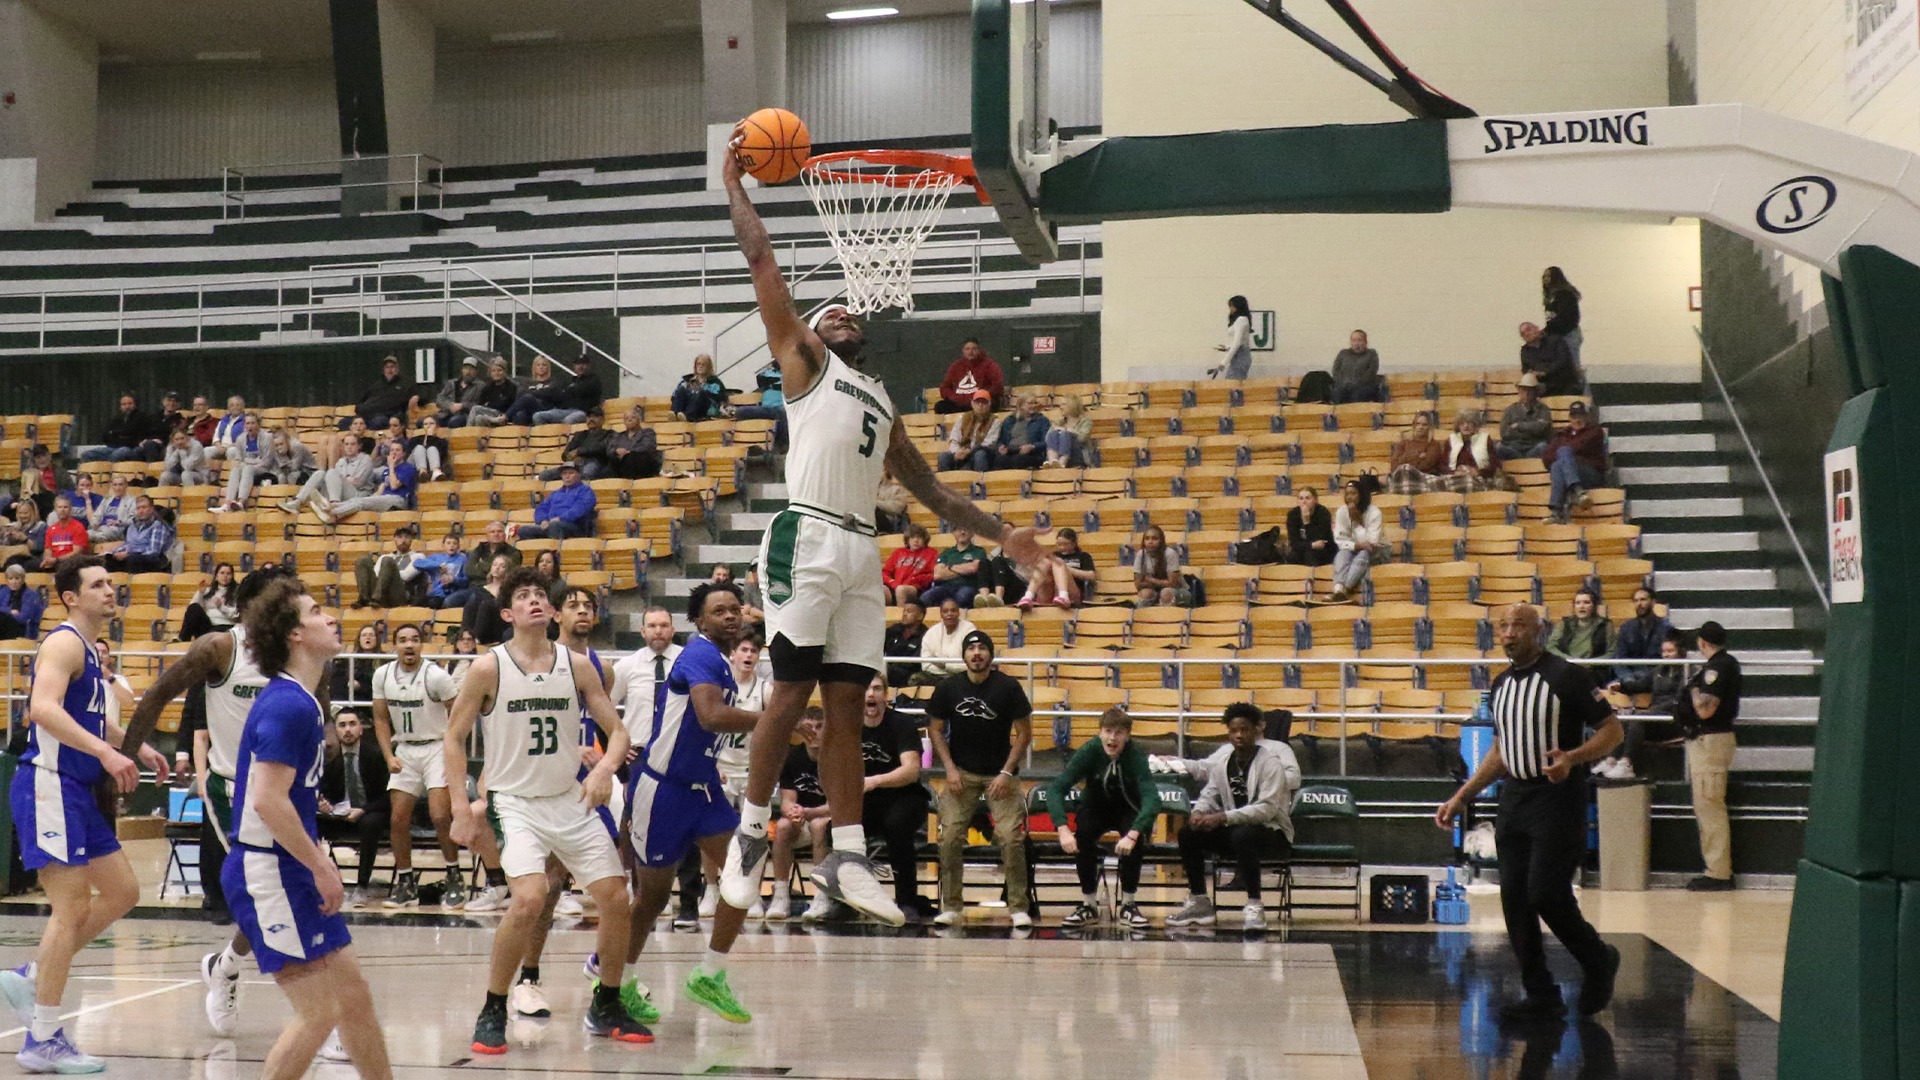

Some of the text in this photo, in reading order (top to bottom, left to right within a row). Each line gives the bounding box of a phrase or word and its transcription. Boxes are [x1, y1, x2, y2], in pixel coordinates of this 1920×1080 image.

[1484, 111, 1648, 153] SPALDING
[1784, 185, 1808, 224] S
[1253, 312, 1269, 348] J
[834, 378, 893, 423] GREYHOUN
[858, 411, 879, 458] 5
[402, 711, 413, 733] 11
[507, 697, 570, 713] GREYHOUNDS
[528, 716, 558, 756] 33
[1302, 793, 1347, 804] ENMU
